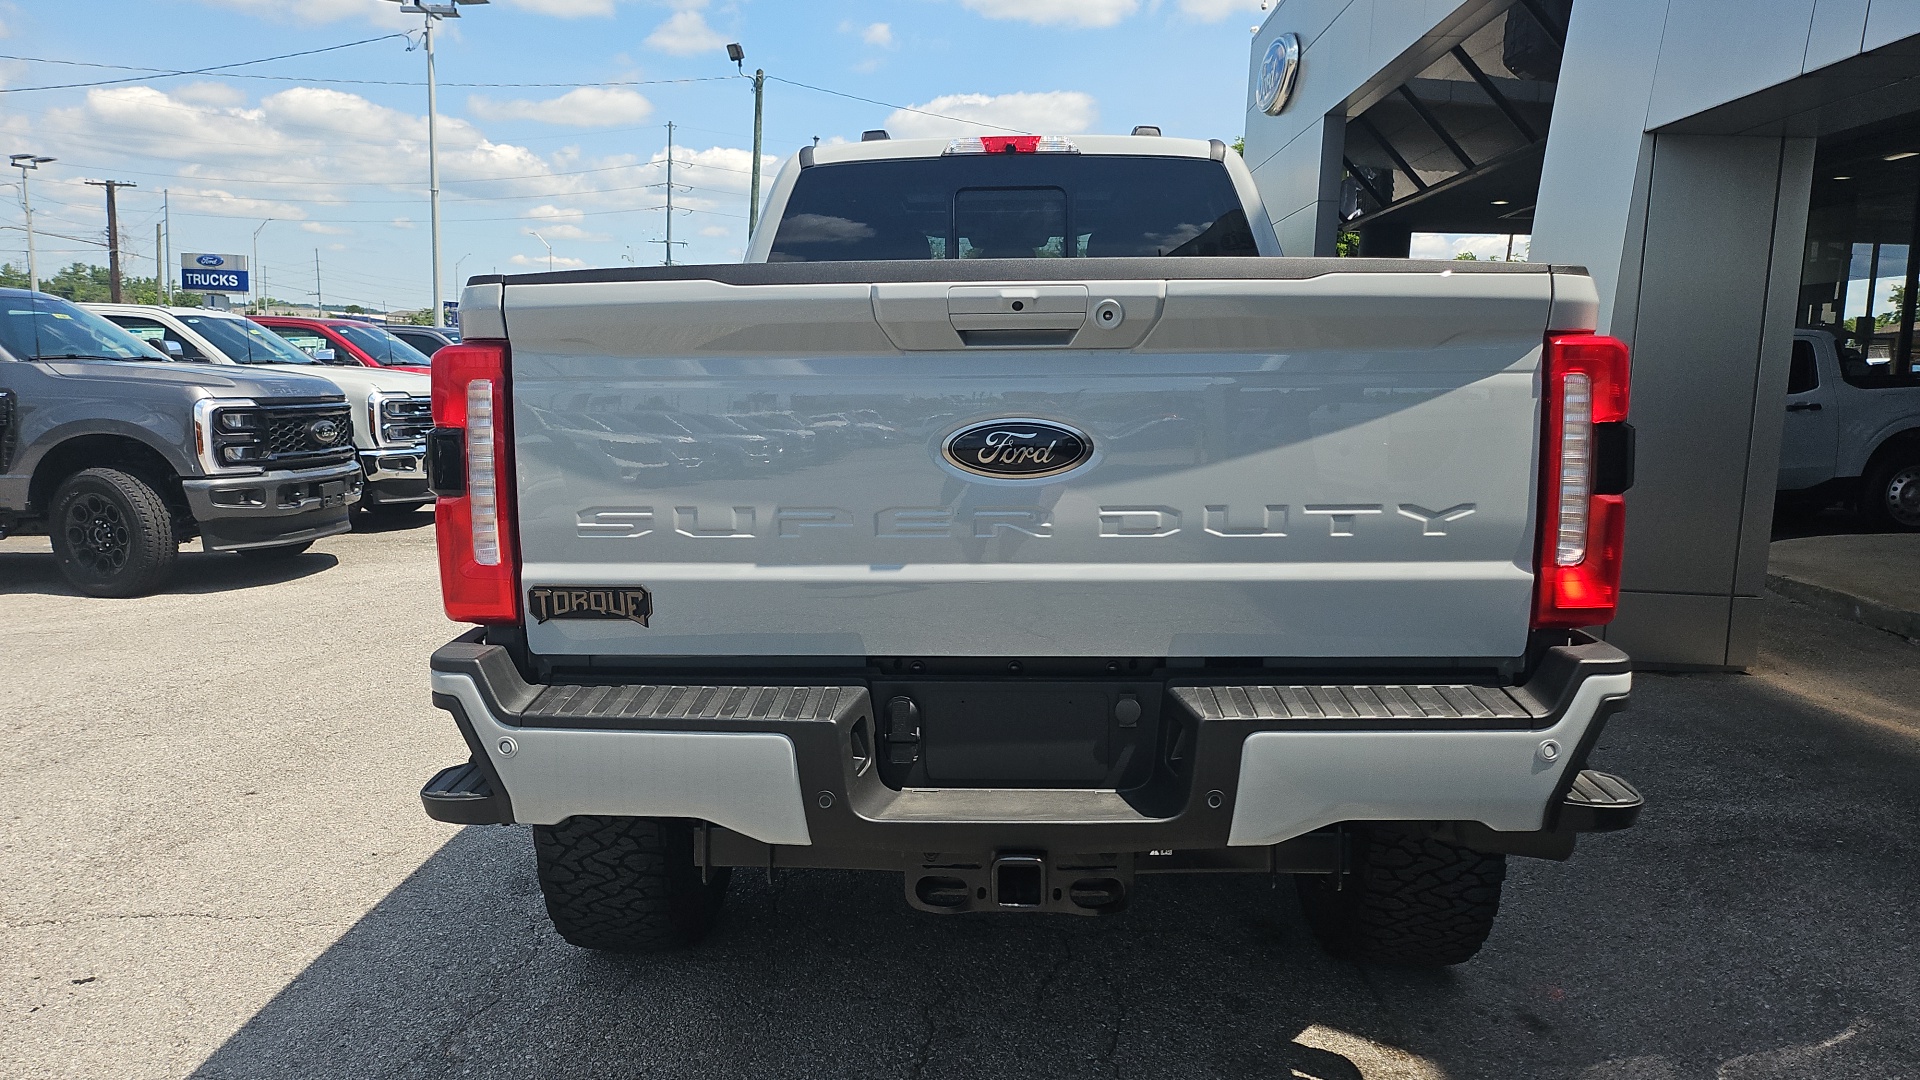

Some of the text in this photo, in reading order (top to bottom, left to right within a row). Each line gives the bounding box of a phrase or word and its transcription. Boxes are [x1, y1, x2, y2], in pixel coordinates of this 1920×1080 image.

[200, 256, 218, 265] Ford
[185, 273, 239, 287] TRUCKS
[977, 430, 1057, 464] Ford
[576, 503, 1477, 538] SUPER DUTY
[534, 590, 648, 626] TORQUE
